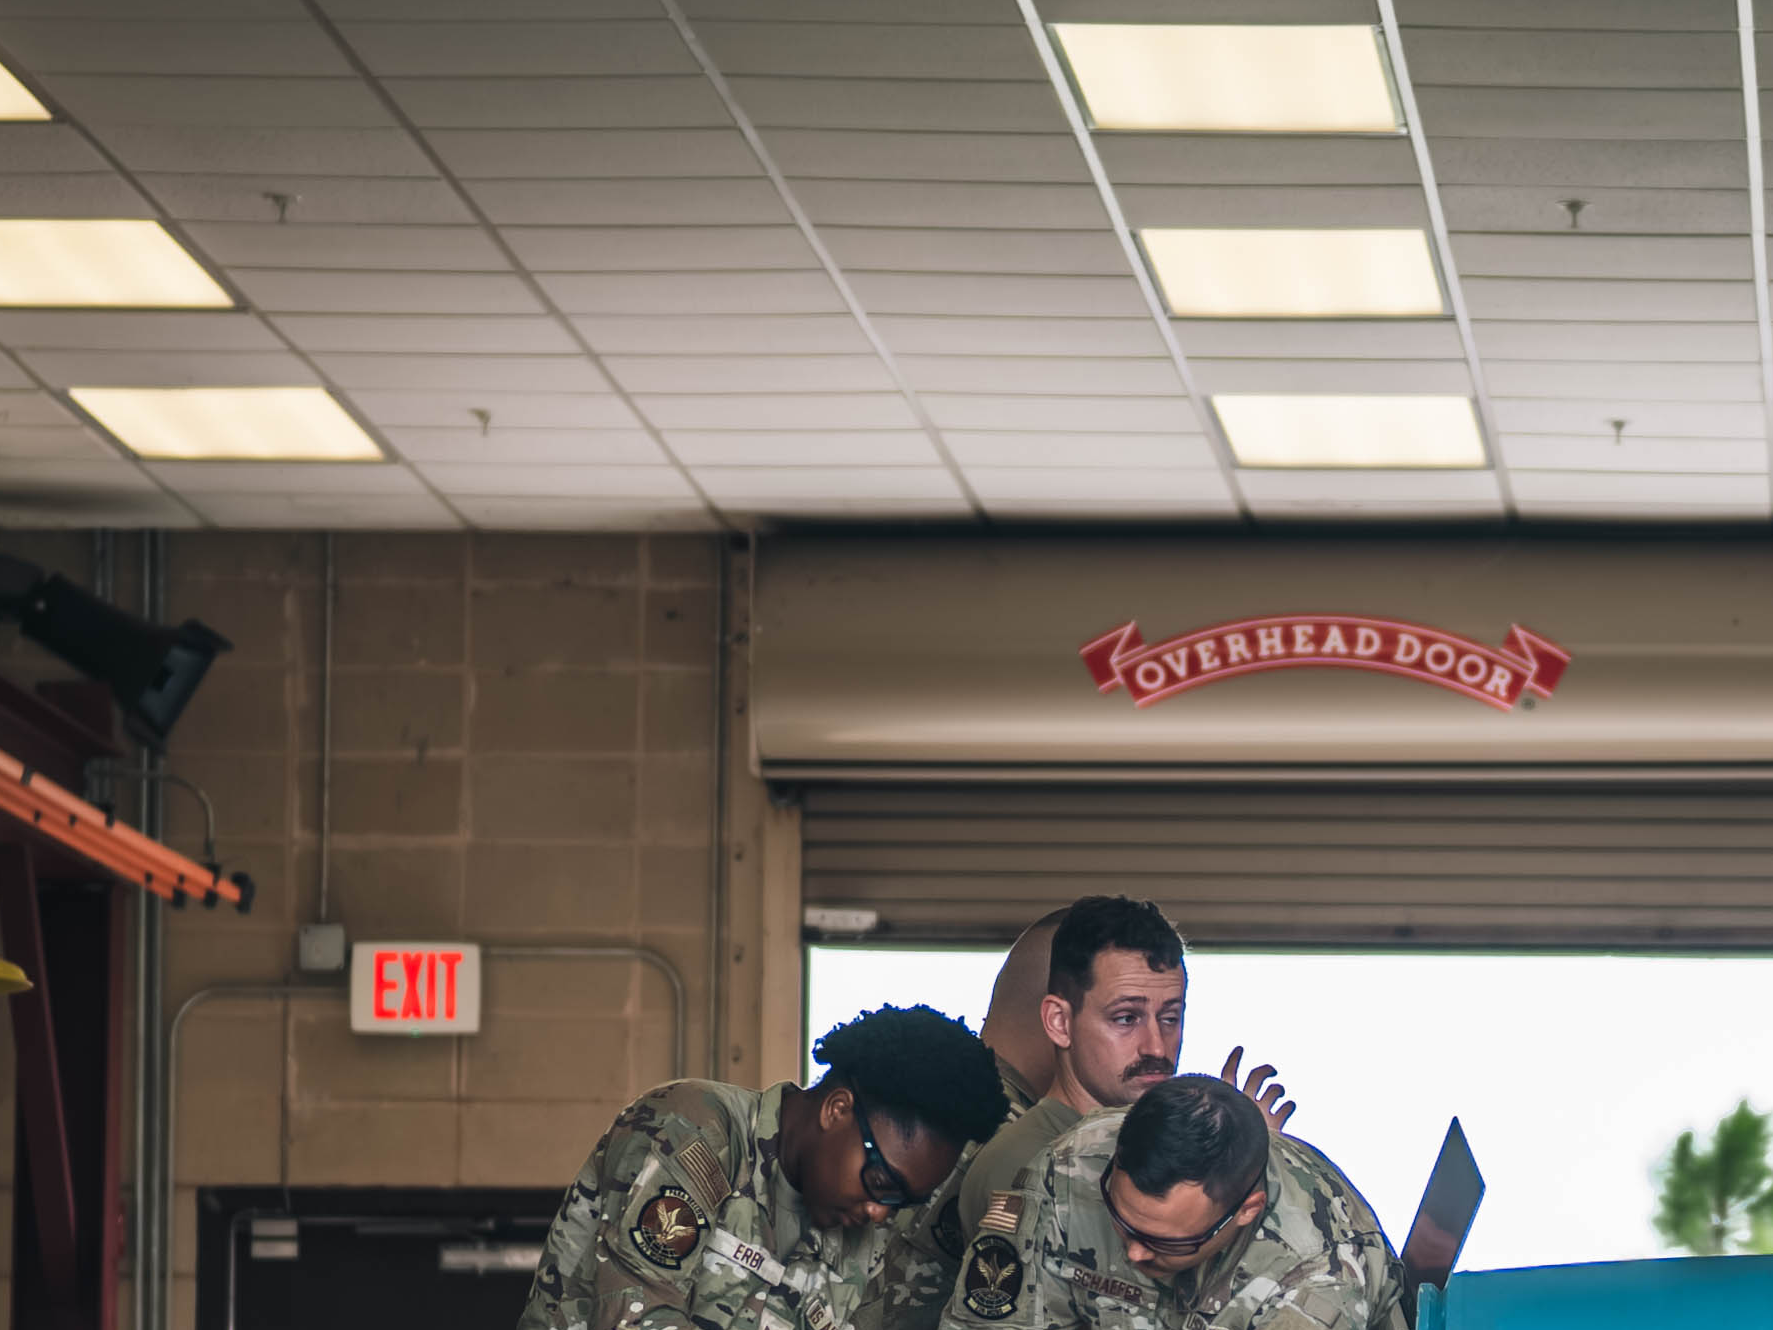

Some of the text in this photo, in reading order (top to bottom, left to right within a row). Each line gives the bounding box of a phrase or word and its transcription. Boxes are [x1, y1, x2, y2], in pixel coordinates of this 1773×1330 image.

[1134, 623, 1513, 698] OVERHEAD DOOR
[373, 951, 463, 1020] EXIT
